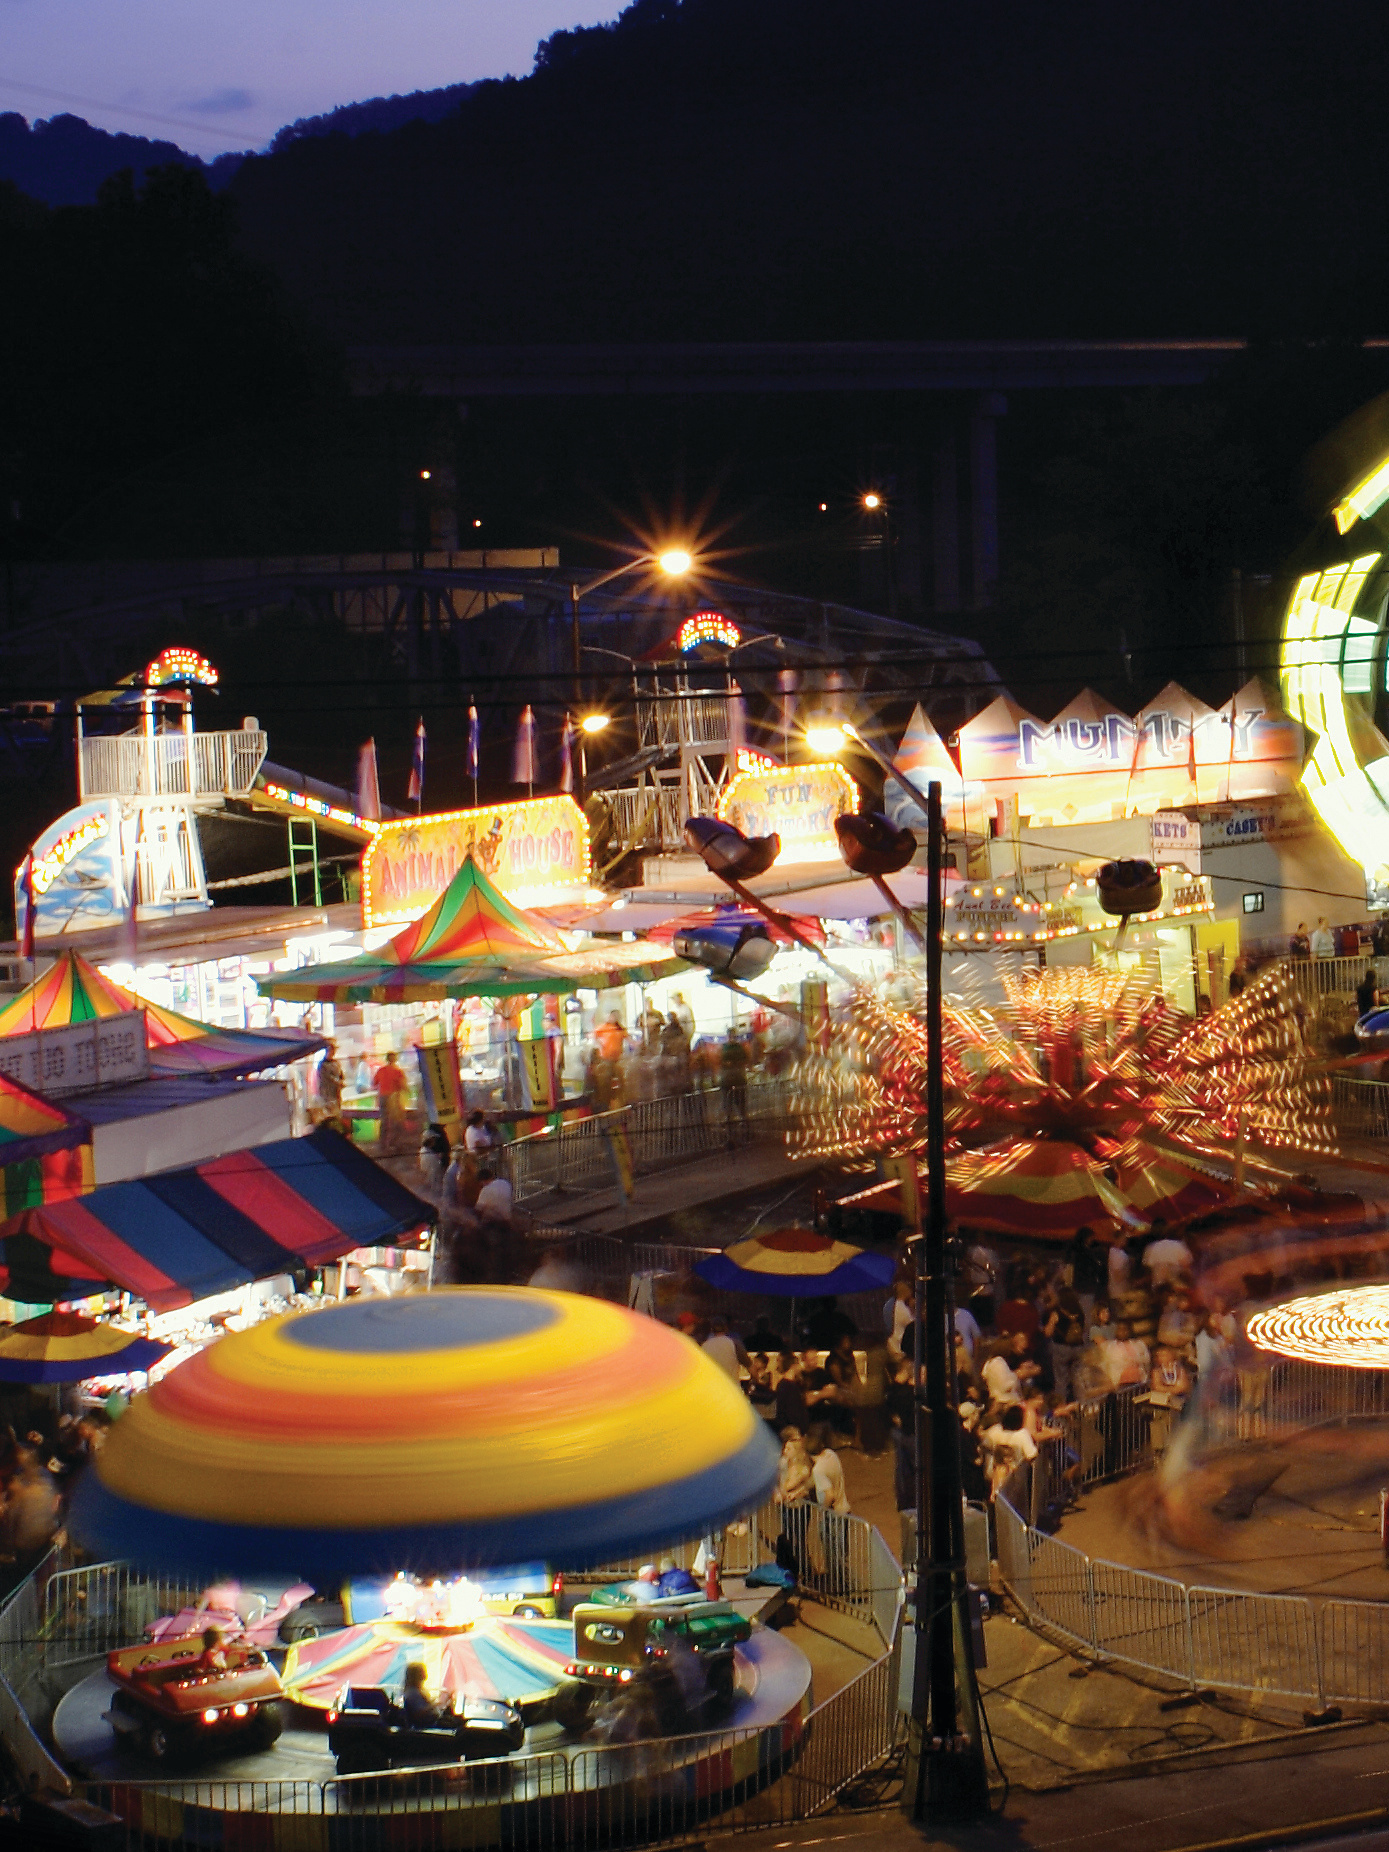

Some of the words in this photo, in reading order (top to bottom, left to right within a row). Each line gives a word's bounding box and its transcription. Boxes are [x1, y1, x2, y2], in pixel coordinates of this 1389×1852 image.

[1016, 708, 1266, 769] MUMMY
[766, 784, 812, 805] FUN
[745, 804, 834, 838] FACTORY
[1154, 822, 1187, 838] KETS
[381, 846, 458, 899] ANIMAL
[510, 827, 575, 874] HOUSE
